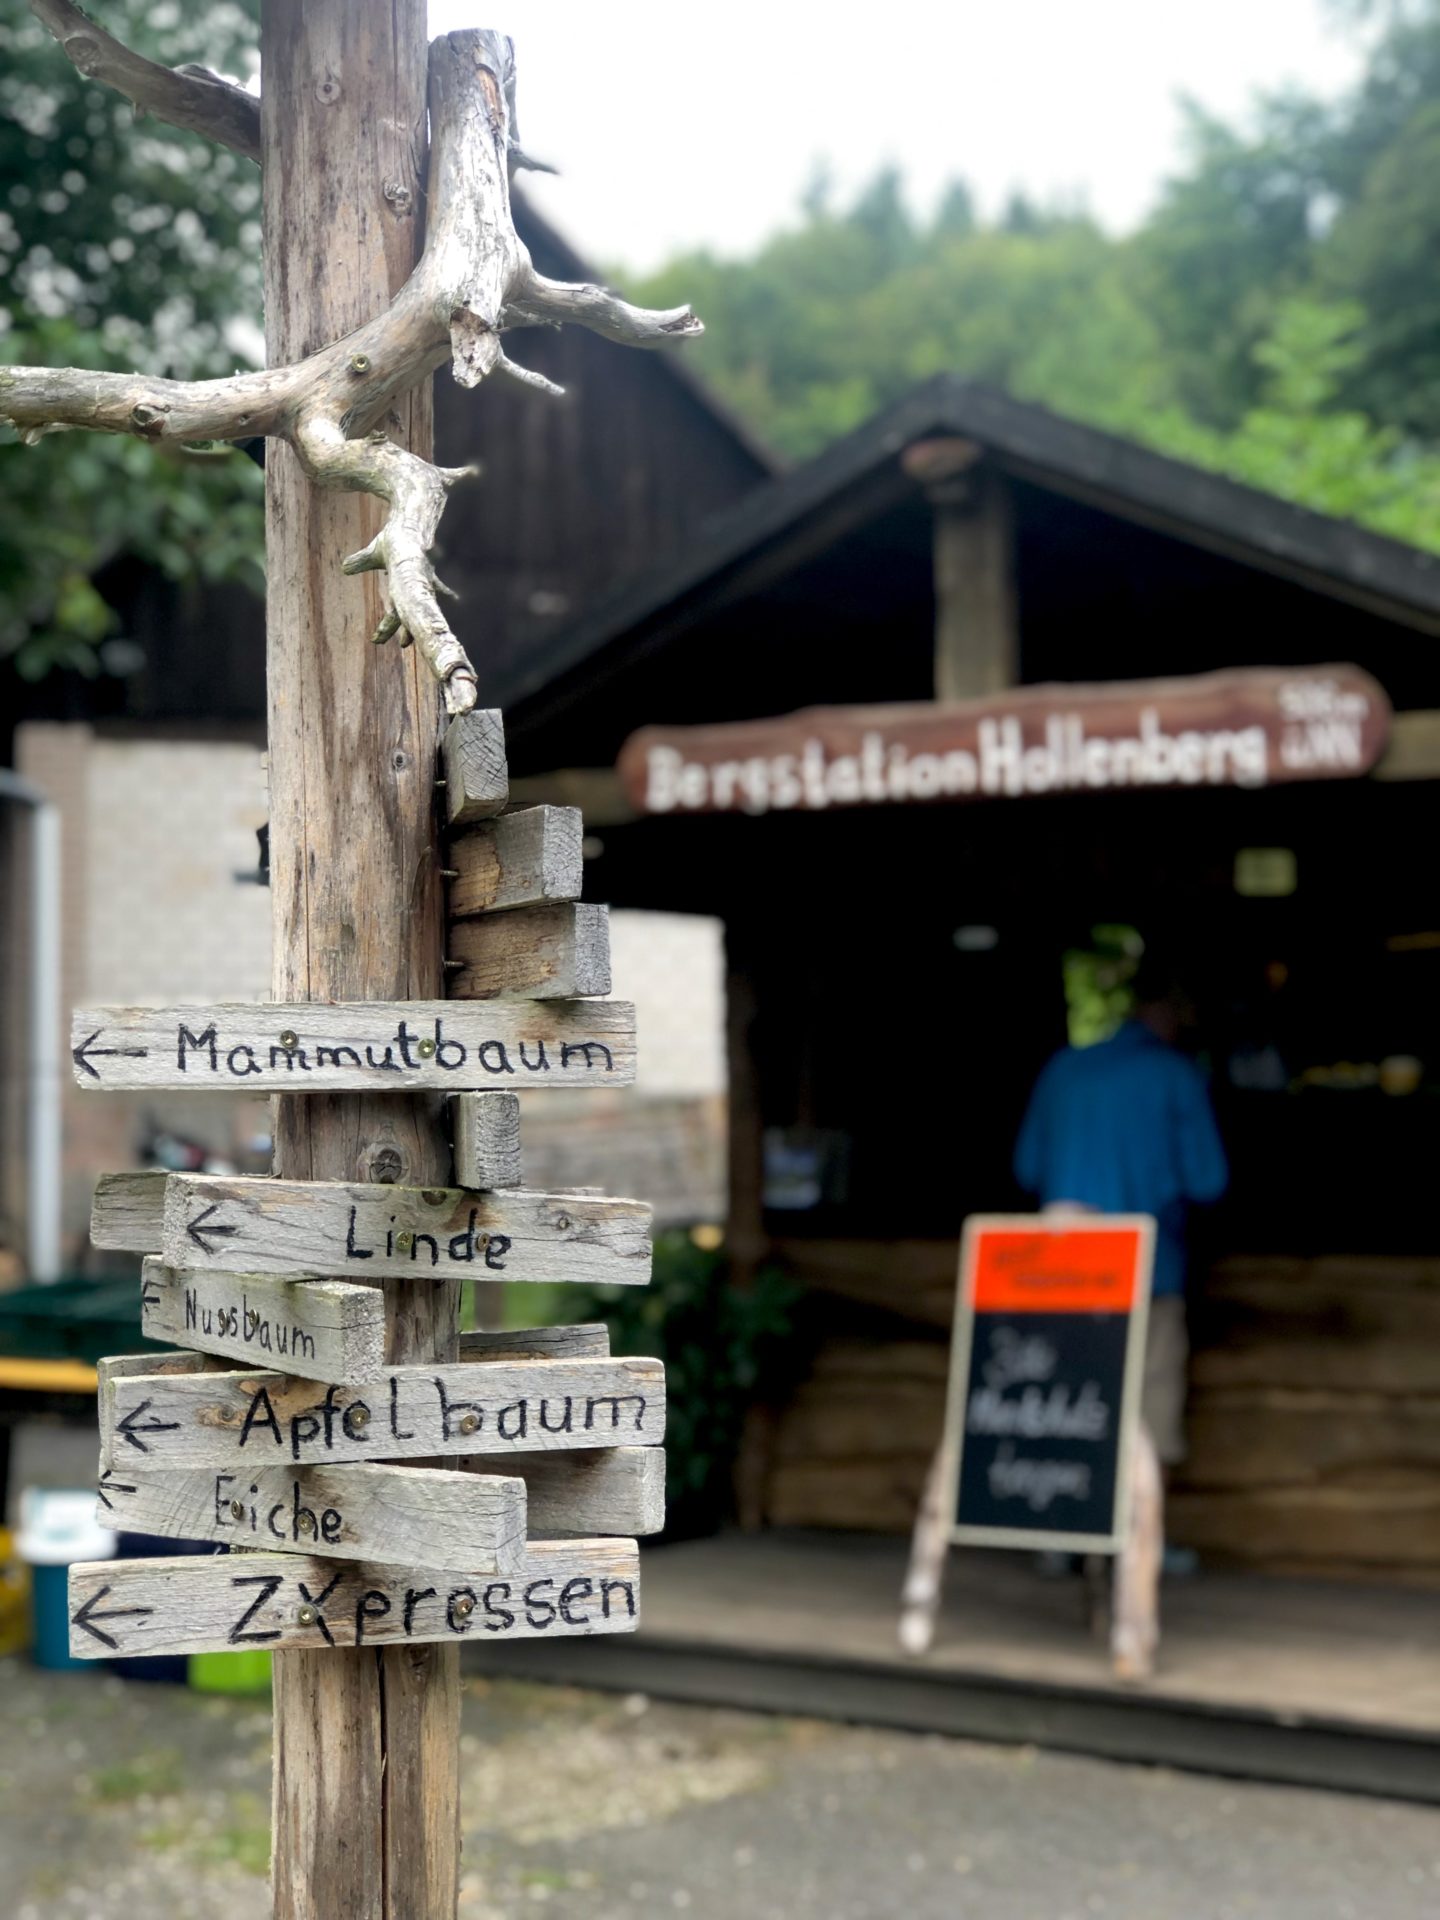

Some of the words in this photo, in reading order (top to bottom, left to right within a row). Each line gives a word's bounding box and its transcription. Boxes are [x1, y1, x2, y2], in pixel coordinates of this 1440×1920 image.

[175, 1018, 614, 1077] Mammutbaum
[345, 1204, 513, 1270] Linde
[185, 1288, 316, 1359] Nussbaum
[238, 1376, 647, 1460] Apfelbaum
[214, 1475, 343, 1544] Eiche
